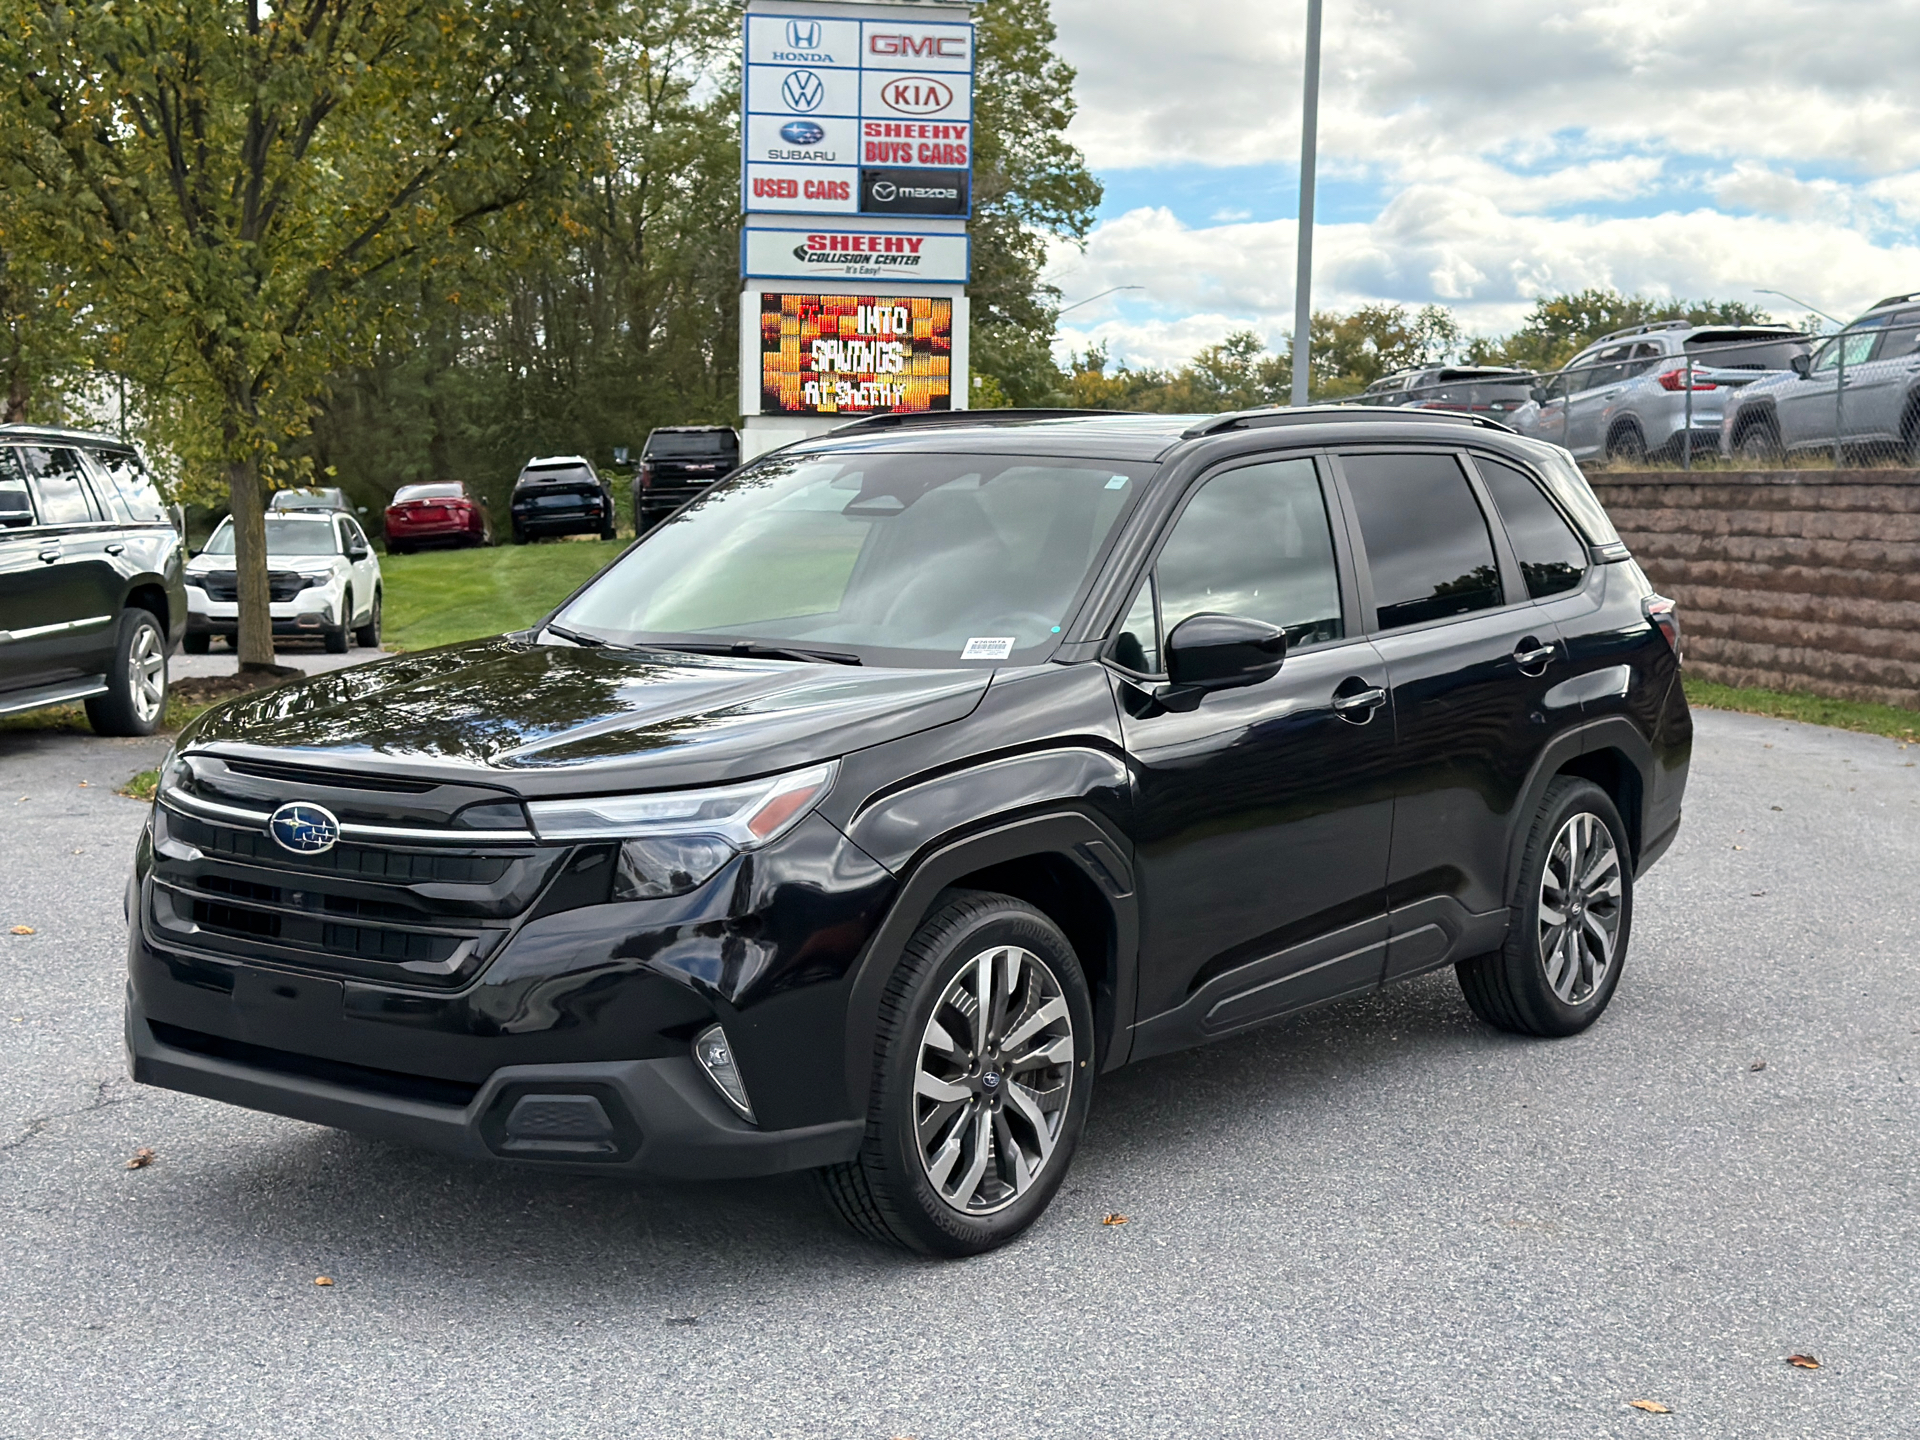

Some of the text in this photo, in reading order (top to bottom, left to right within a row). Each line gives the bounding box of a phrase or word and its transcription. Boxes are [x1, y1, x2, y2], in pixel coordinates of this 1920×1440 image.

[870, 34, 966, 59] GMC
[772, 51, 835, 63] HONDA
[894, 84, 941, 107] KIA
[864, 123, 967, 139] SHEEHY
[768, 149, 836, 161] SUBARU
[865, 141, 967, 165] BUYS CARS
[753, 177, 850, 200] USED CARS
[899, 187, 958, 198] mazda
[807, 234, 924, 253] SHEEHY
[807, 252, 921, 266] COLLISION CENTER
[845, 265, 882, 276] It's Easy!
[857, 305, 908, 334] INTO
[804, 380, 830, 405] AT
